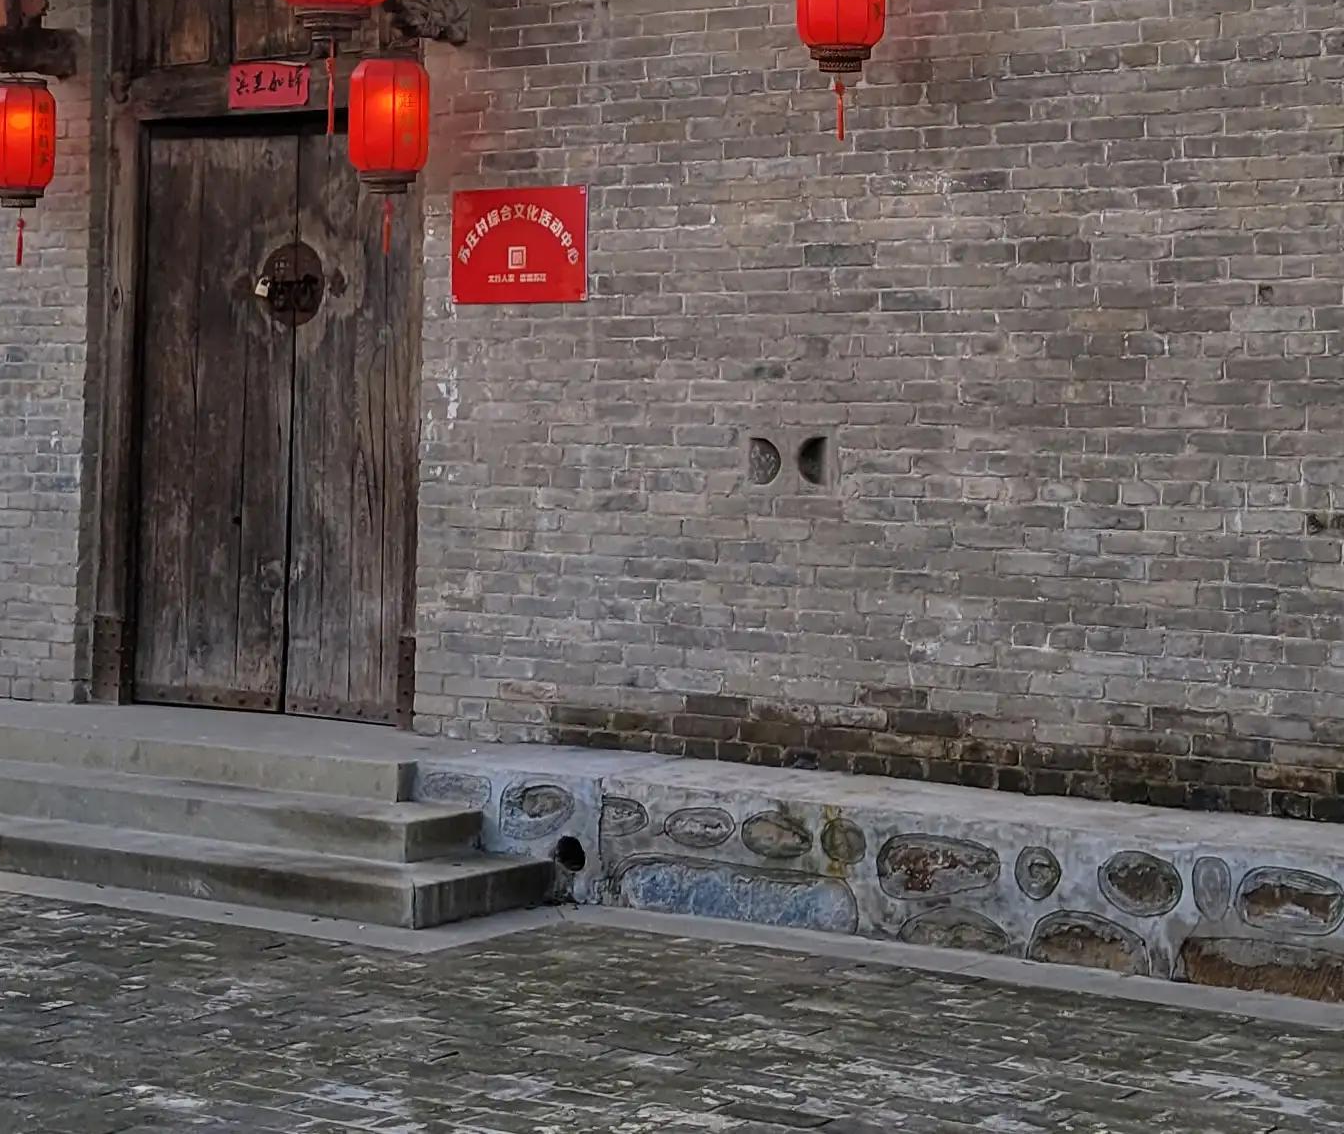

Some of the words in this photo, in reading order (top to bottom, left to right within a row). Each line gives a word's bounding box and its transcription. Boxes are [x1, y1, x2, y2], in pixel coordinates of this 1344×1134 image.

[457, 203, 580, 265] 苏庄村综合文化活动中心
